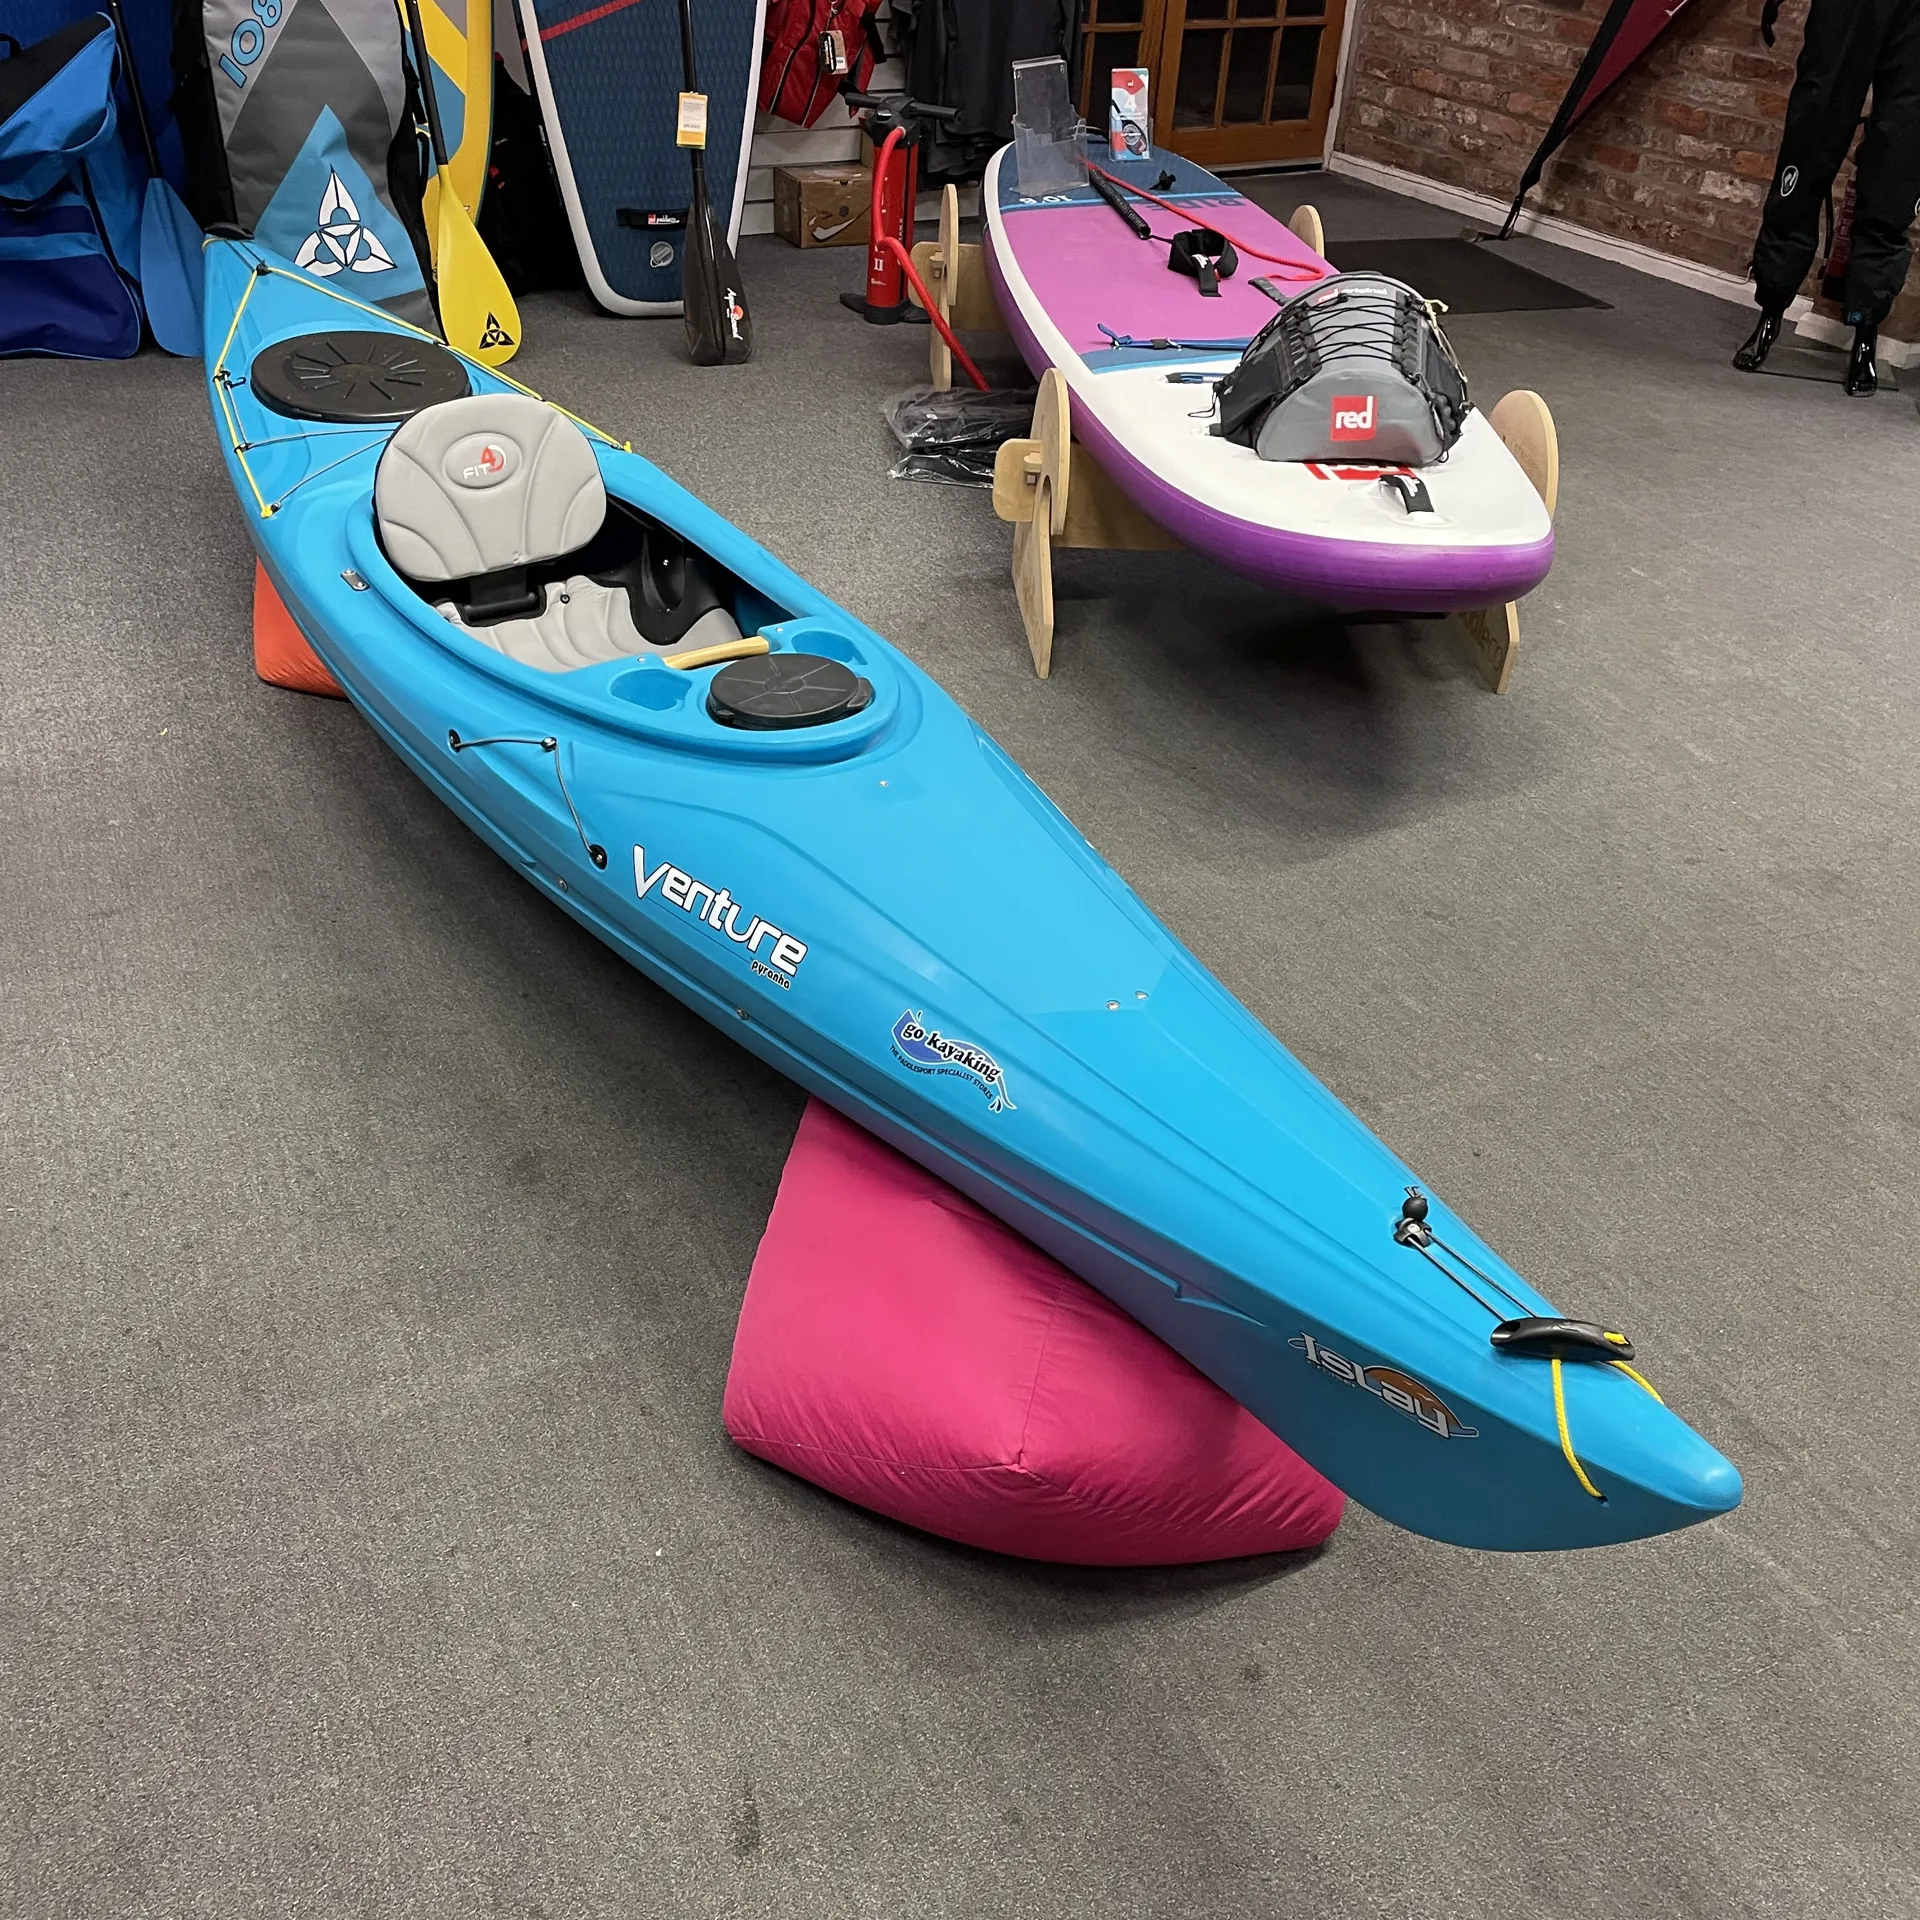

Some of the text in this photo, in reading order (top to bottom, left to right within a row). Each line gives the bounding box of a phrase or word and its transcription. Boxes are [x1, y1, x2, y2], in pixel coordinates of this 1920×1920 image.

[1335, 396, 1373, 429] red
[463, 462, 491, 479] FIT
[633, 844, 808, 977] Venture
[751, 959, 791, 991] pyranha
[889, 1044, 993, 1100] THE PADDLESPORT SPECIALIST STORES
[902, 1023, 1001, 1083] go kayaking
